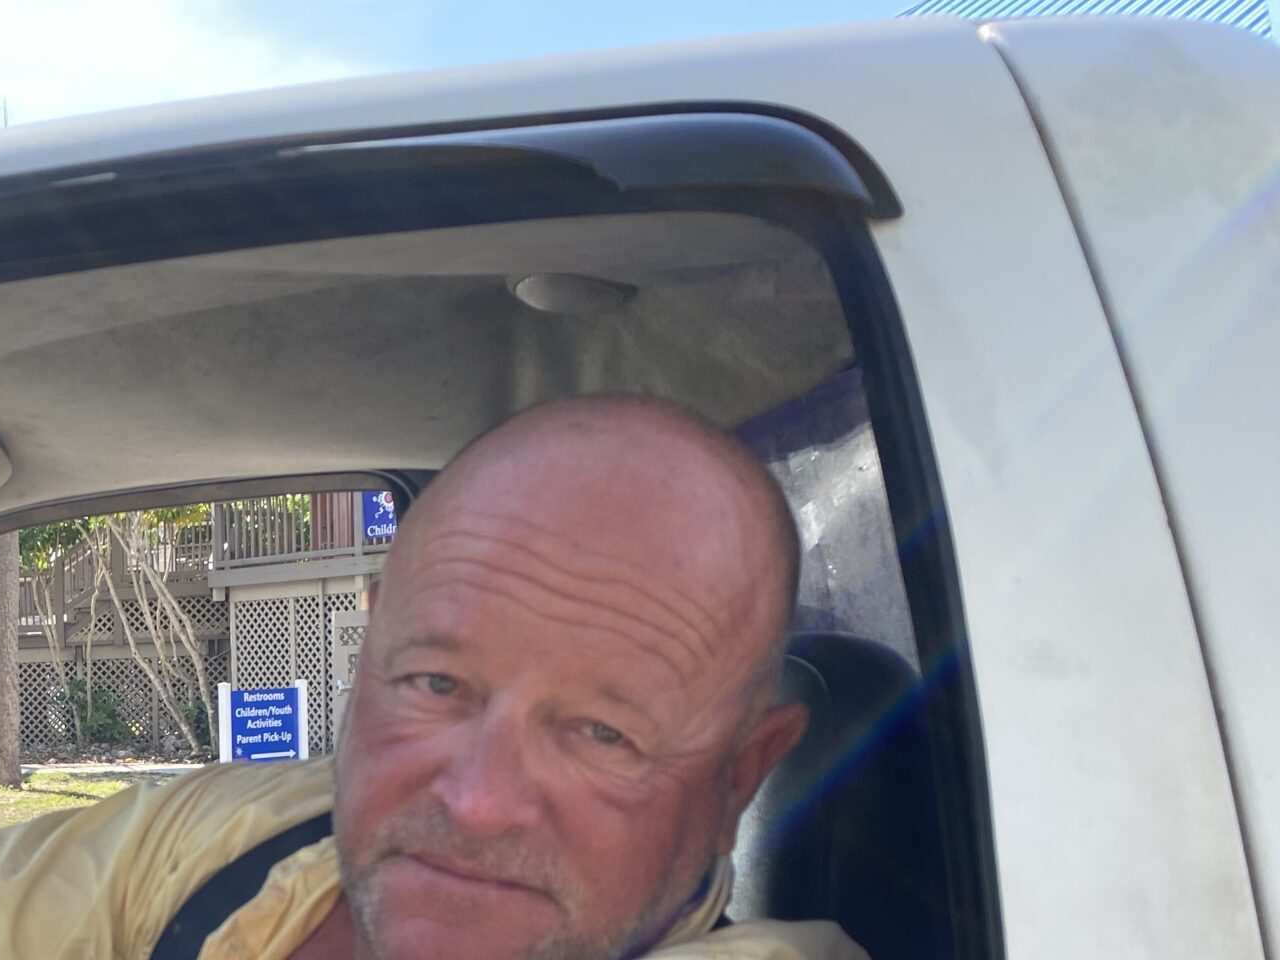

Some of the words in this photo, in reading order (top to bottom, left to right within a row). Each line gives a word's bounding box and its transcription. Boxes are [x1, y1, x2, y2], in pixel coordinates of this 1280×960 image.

[243, 692, 285, 702] Restrooms
[235, 705, 292, 717] Children/Youth
[247, 717, 282, 729] Activities
[236, 734, 261, 744] Parent
[263, 731, 292, 743] Pick-Up
